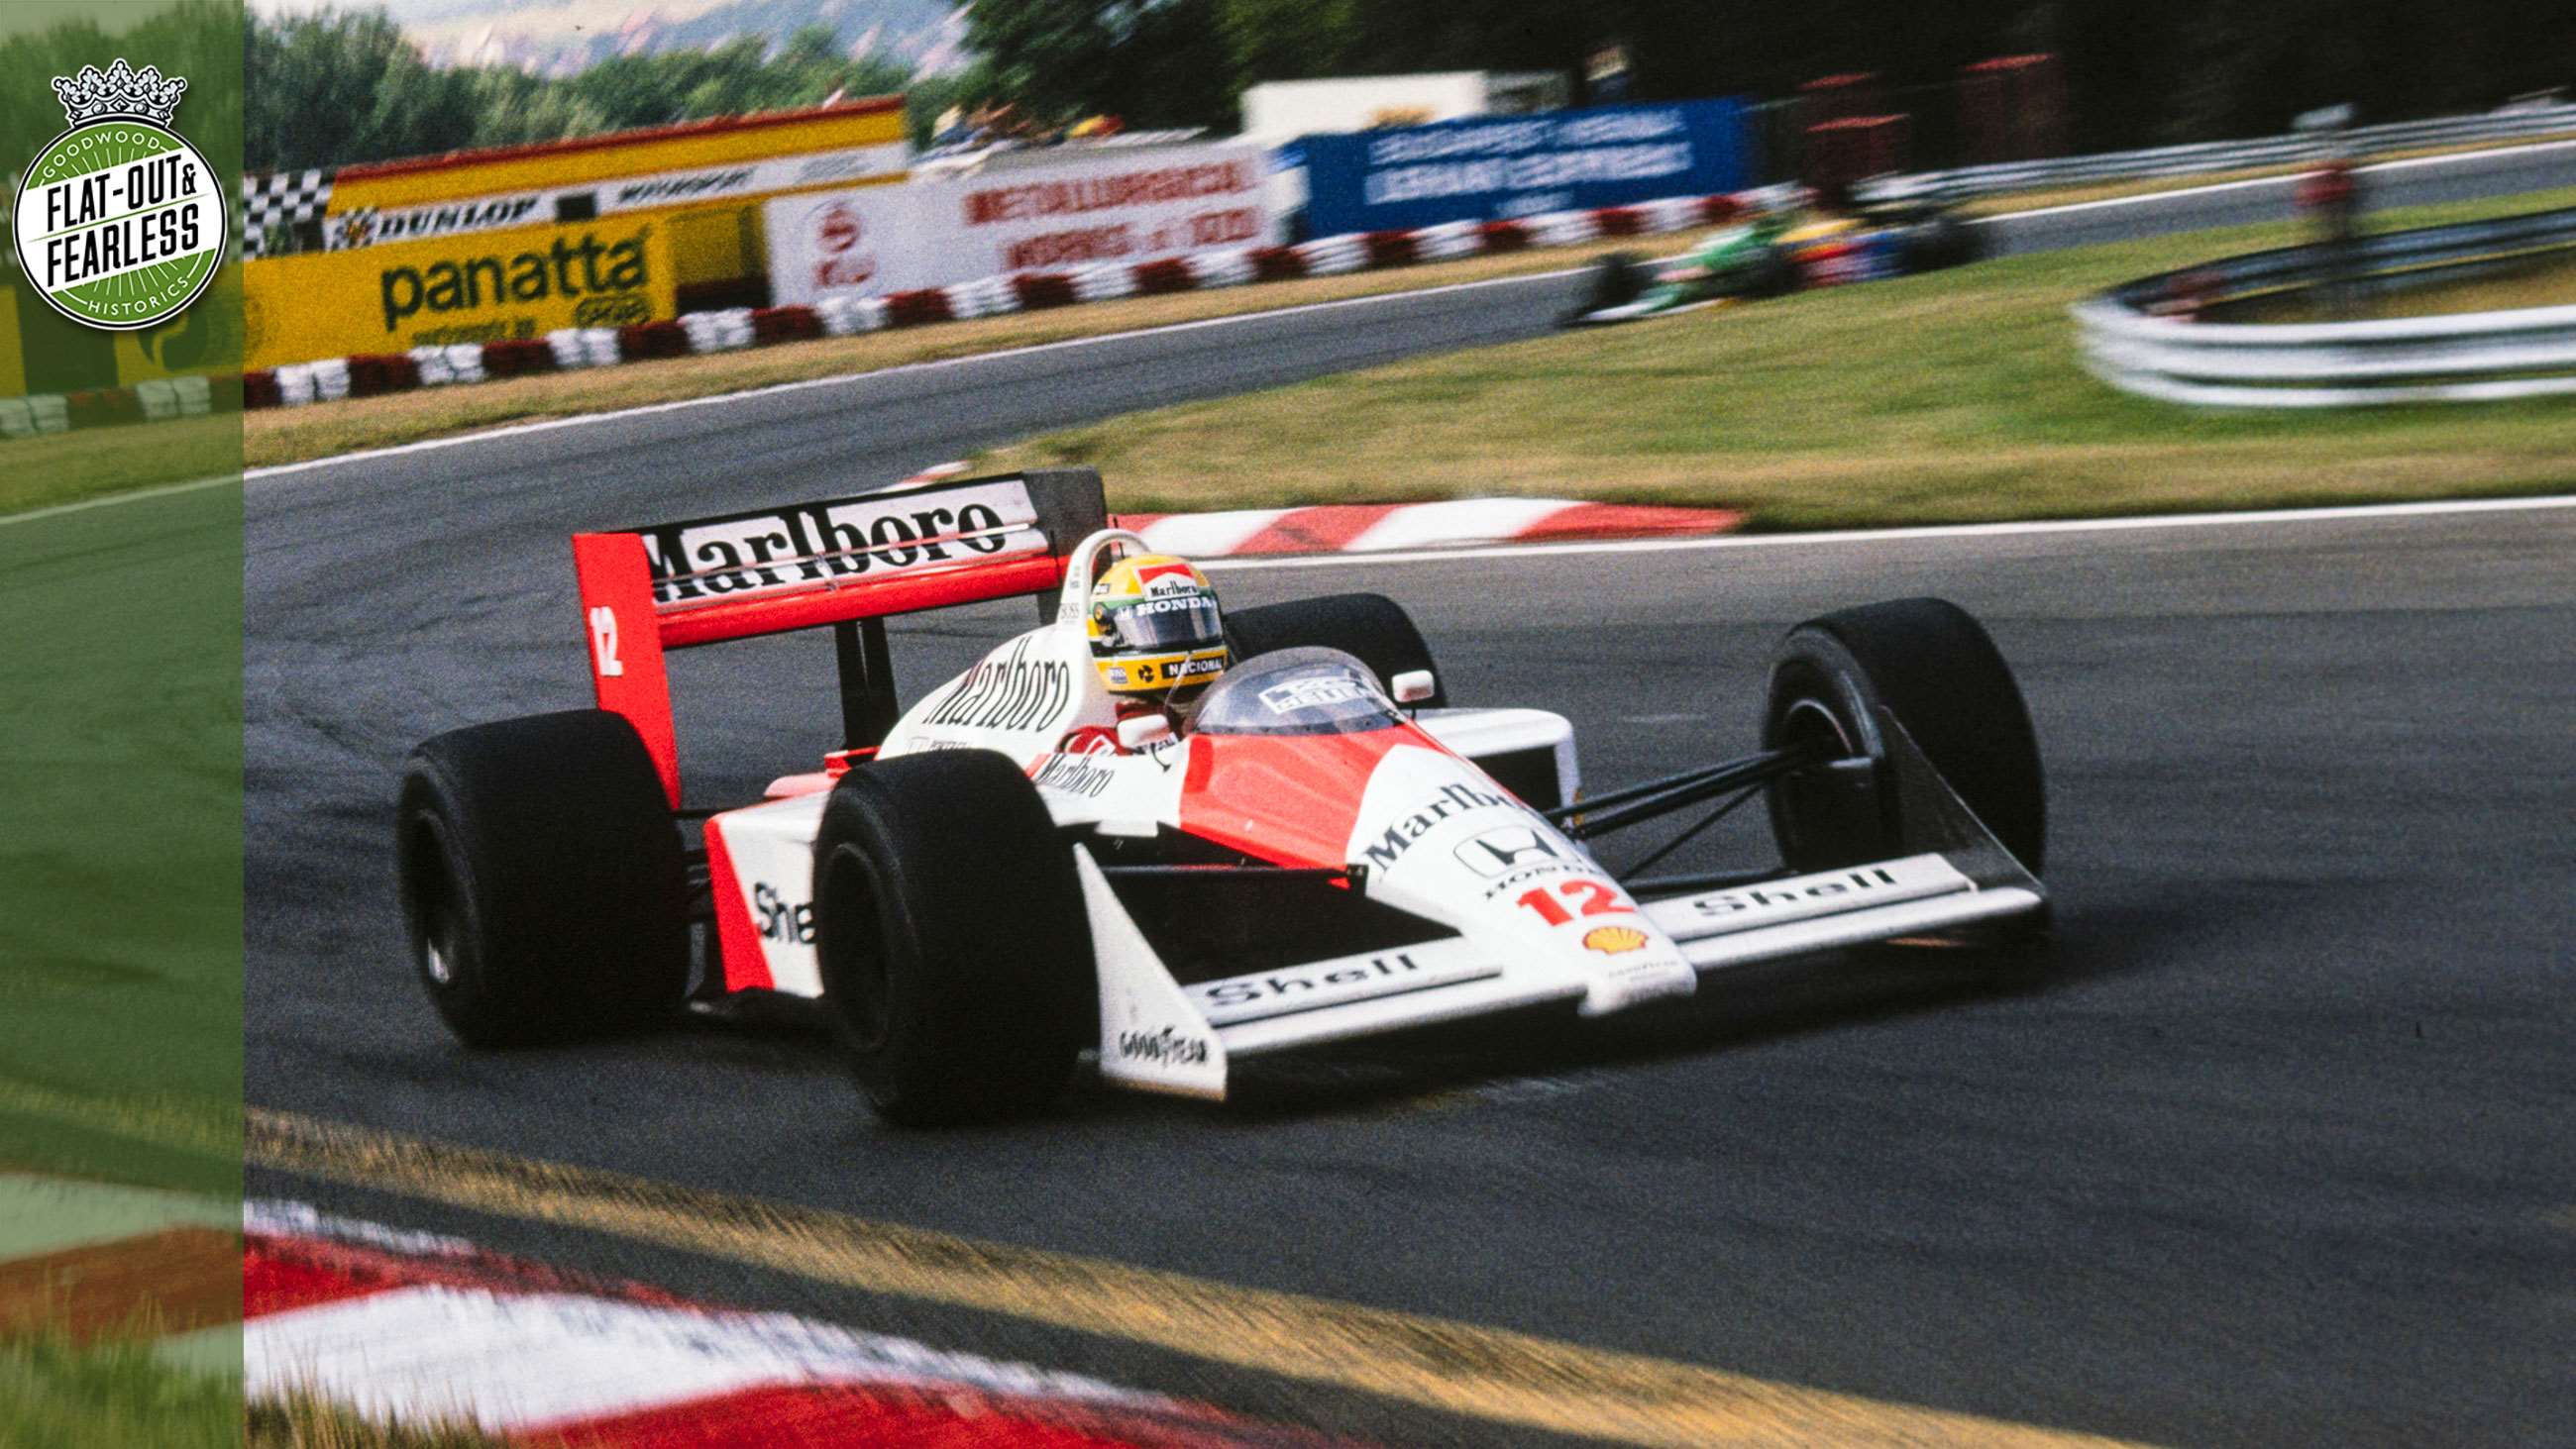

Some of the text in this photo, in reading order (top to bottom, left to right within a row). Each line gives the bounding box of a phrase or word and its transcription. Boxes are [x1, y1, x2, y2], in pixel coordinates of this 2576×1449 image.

[378, 196, 539, 237] DUNLOP
[644, 503, 1007, 603] Marlboro
[1135, 595, 1214, 617] HONDA
[590, 605, 623, 677] 12
[923, 636, 1070, 733] Marlboro
[754, 881, 816, 945] She
[1515, 879, 1640, 928] 12
[1692, 868, 1897, 917] Shell
[1206, 954, 1419, 1007] Shell
